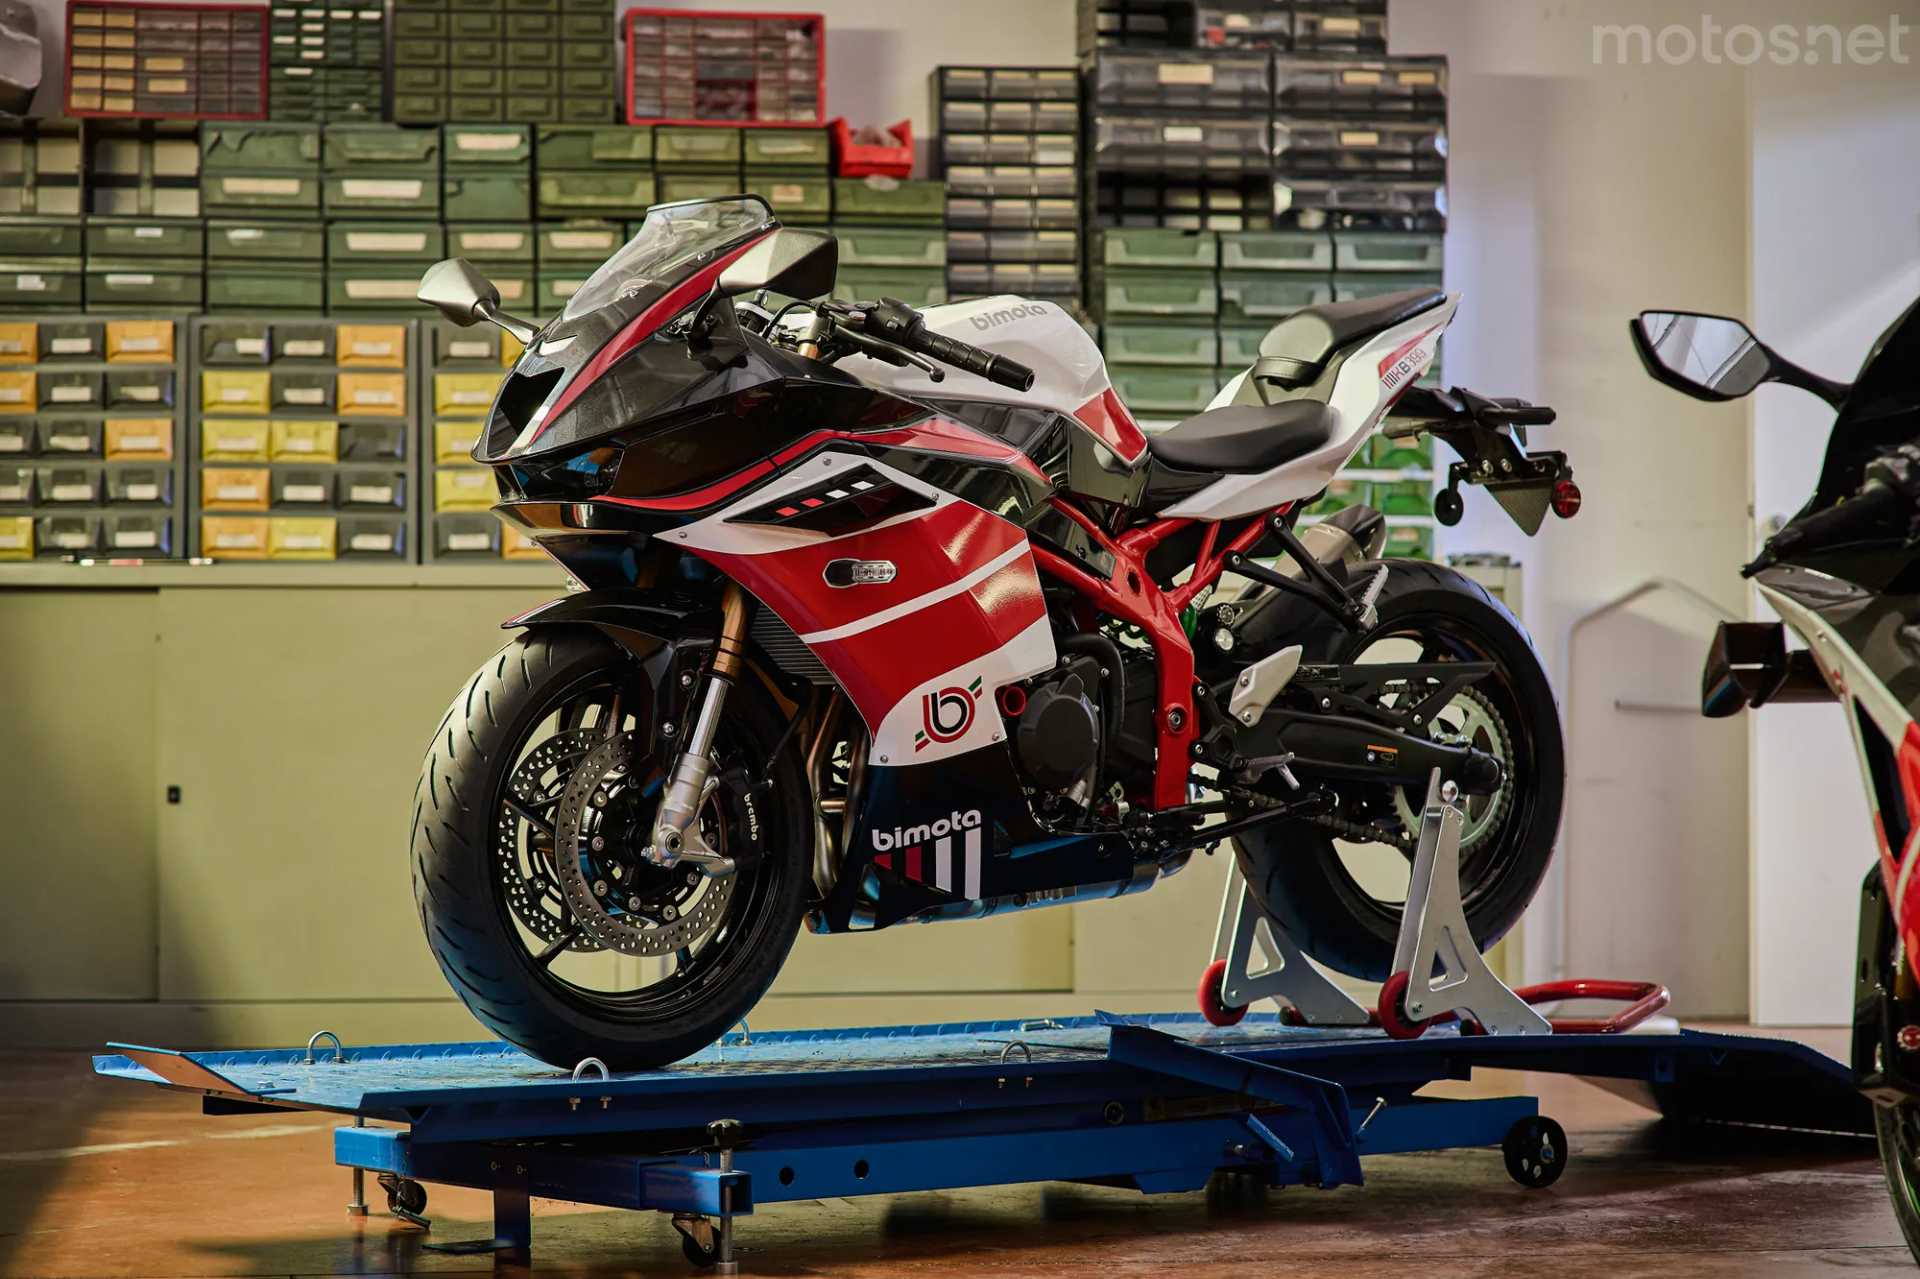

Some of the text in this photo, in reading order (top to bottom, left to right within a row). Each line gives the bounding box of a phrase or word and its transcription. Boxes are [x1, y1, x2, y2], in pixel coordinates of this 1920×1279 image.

[968, 304, 1048, 331] bimota
[743, 792, 759, 841] brembo
[871, 809, 982, 852] bimota
